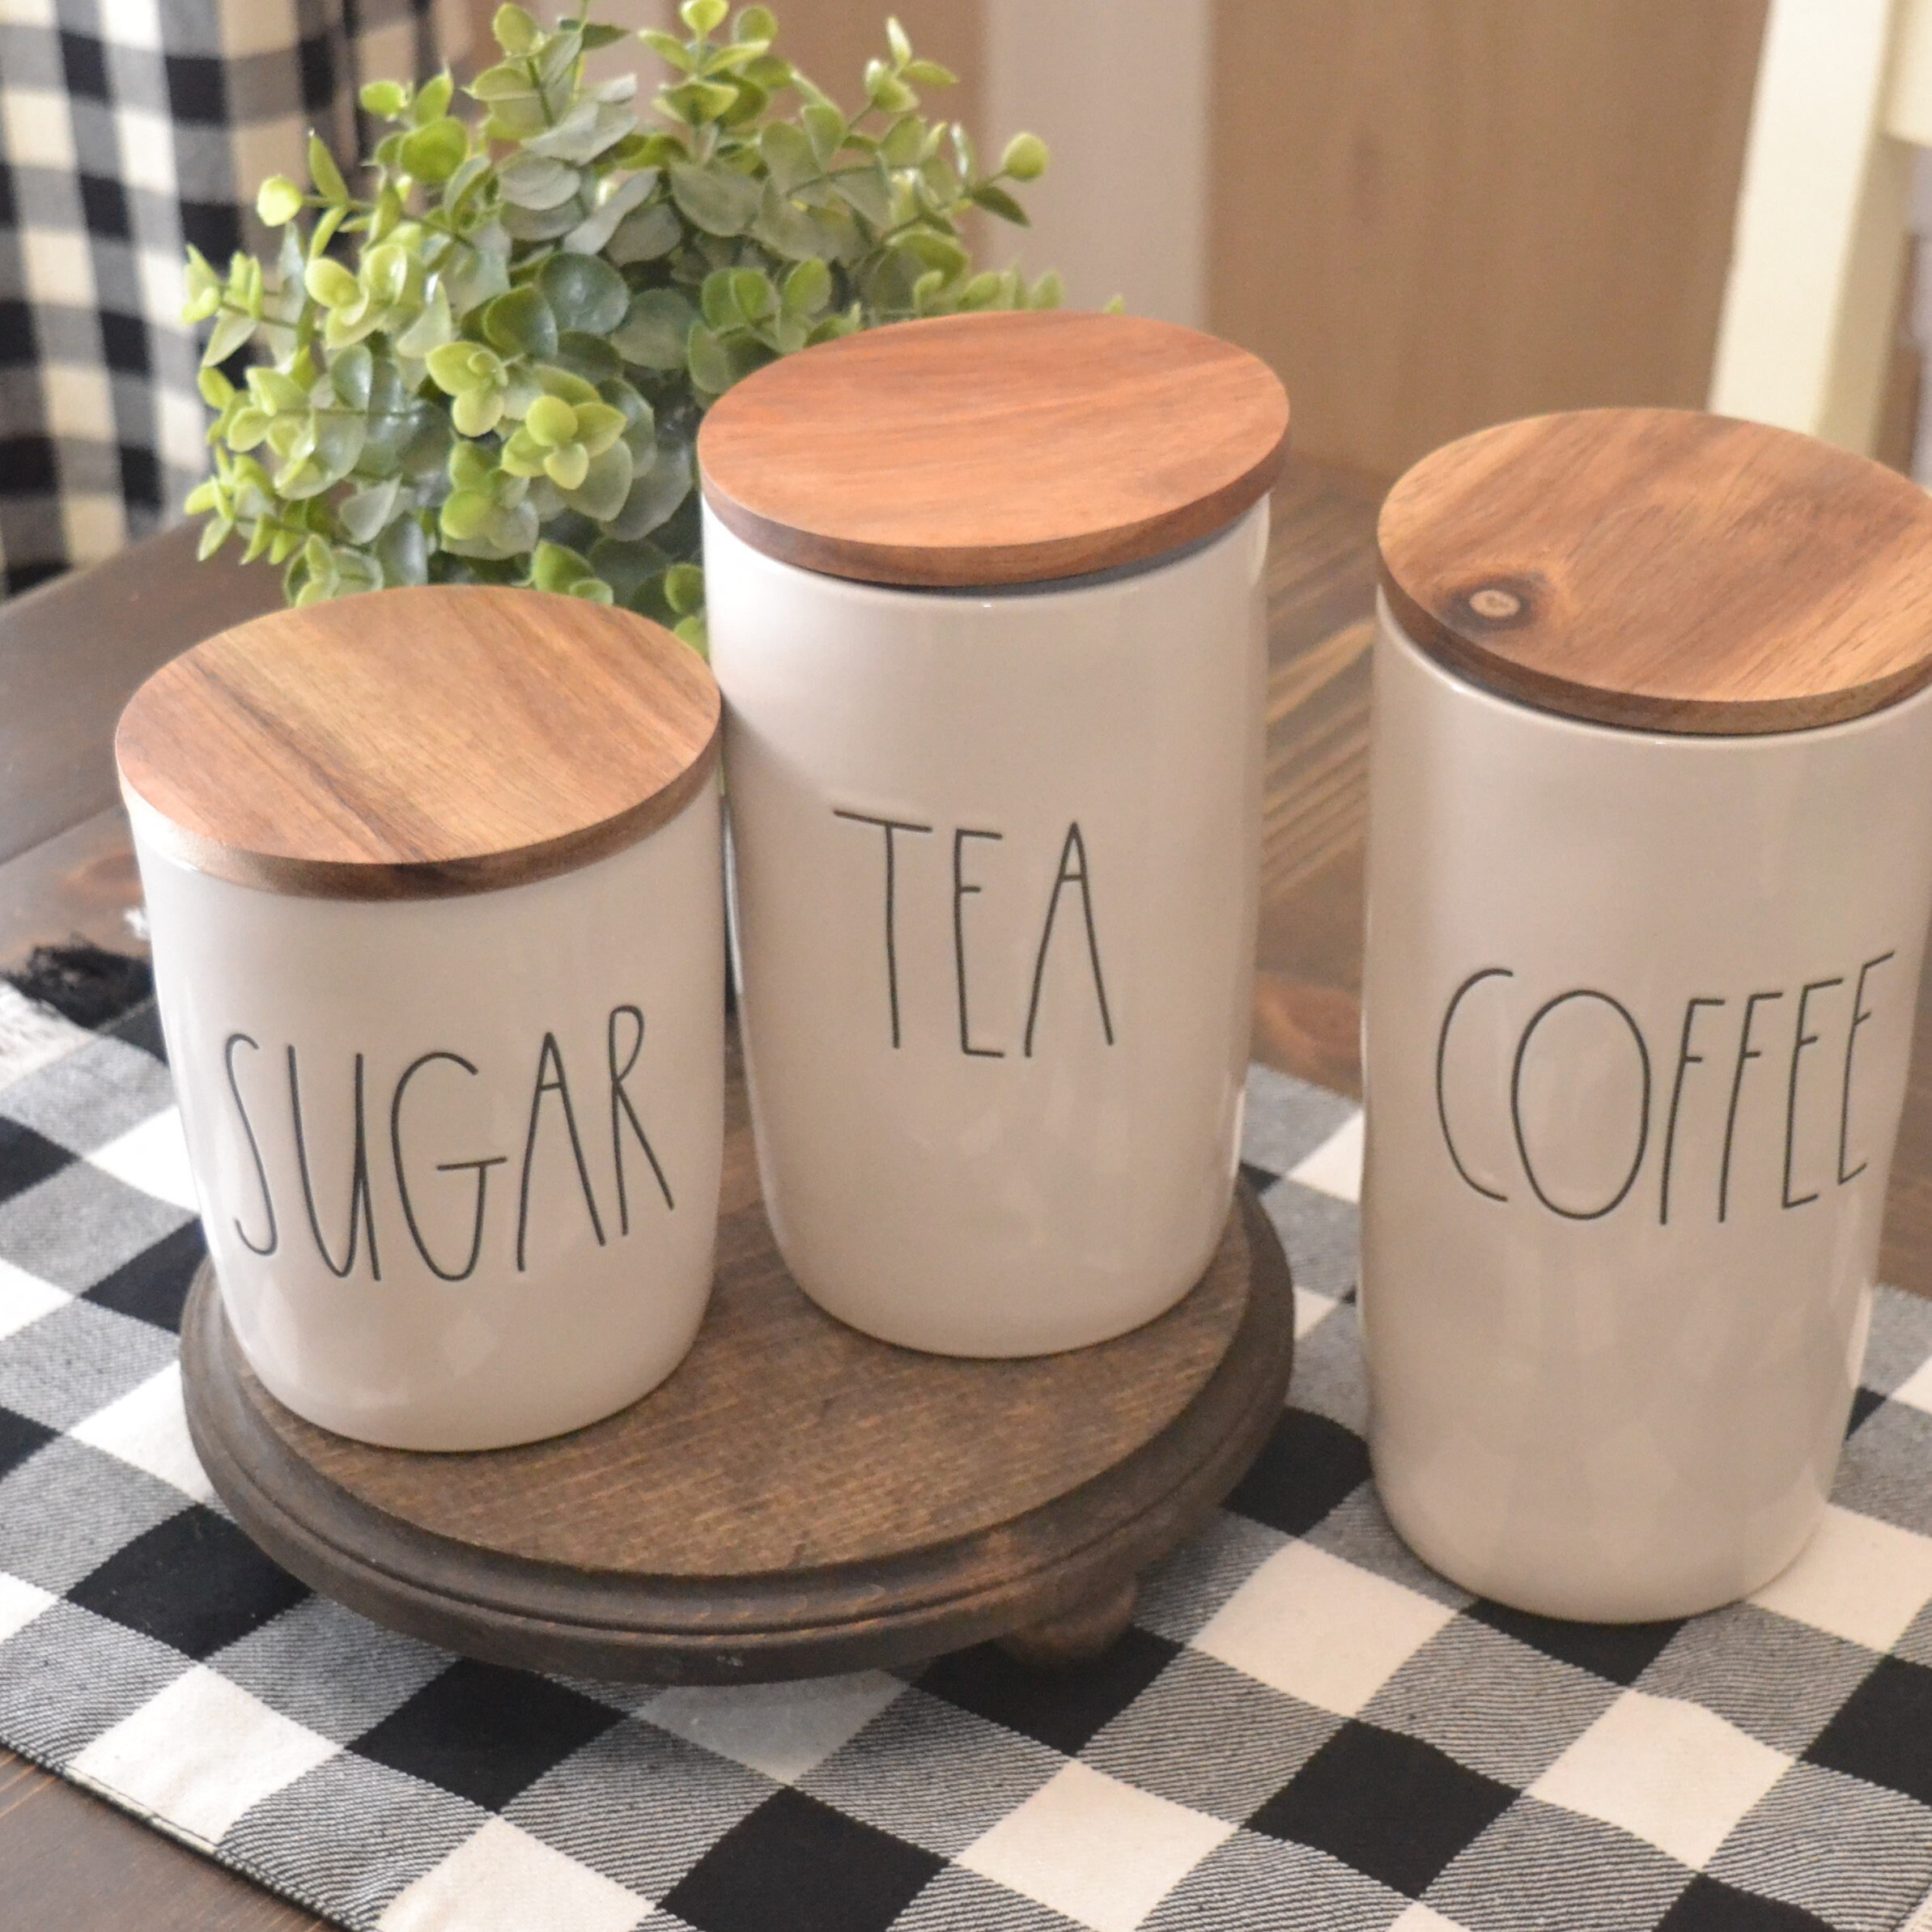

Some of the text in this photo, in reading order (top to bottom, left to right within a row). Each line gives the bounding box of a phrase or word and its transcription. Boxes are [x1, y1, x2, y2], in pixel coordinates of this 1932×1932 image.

[833, 808, 1115, 1059] TEA
[223, 1004, 677, 1283] SUGAR
[1436, 950, 1896, 1227] COFFEE
